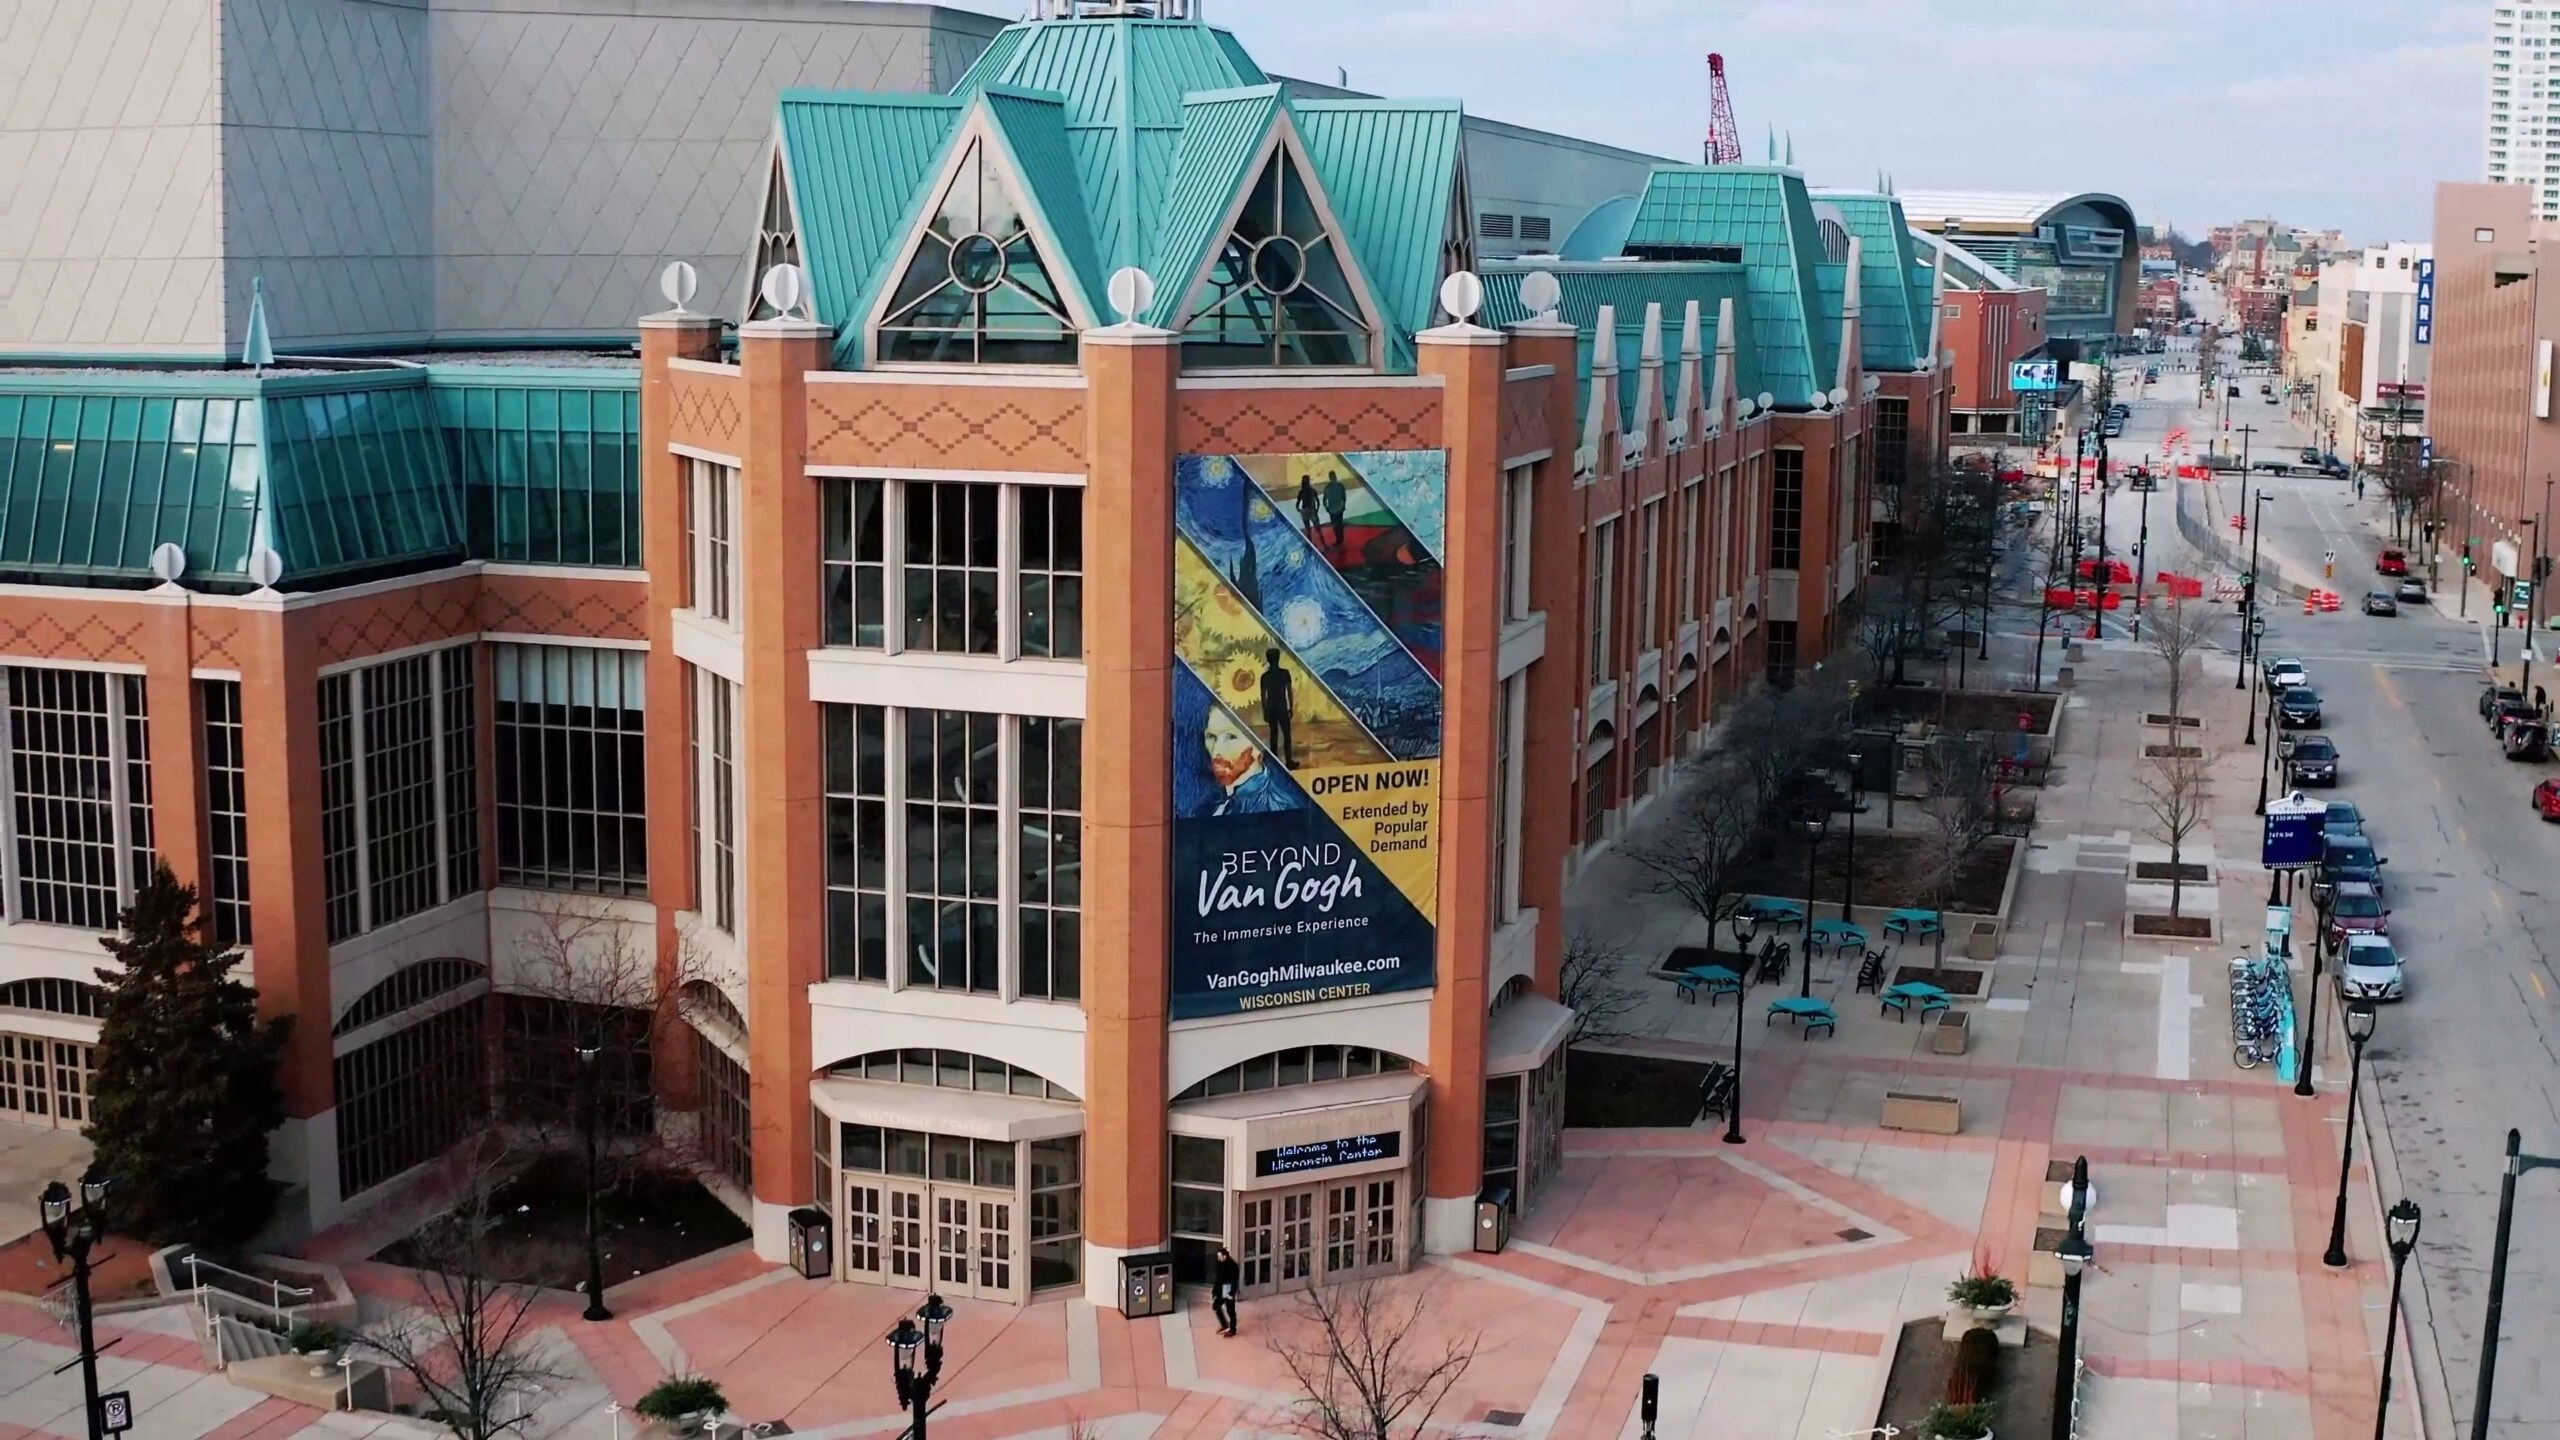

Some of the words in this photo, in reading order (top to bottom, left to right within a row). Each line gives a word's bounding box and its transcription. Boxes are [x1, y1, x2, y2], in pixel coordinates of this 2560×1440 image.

[2418, 262, 2431, 342] PARK
[1312, 773, 1369, 795] OPEN
[1376, 768, 1429, 790] NOW!
[1343, 801, 1408, 820] Extended
[1412, 800, 1428, 817] by
[1374, 818, 1428, 836] Popular
[1370, 835, 1427, 853] Demand
[1222, 843, 1341, 875] BEYOND
[1198, 869, 1265, 917] Van
[1274, 858, 1362, 912] Gogh
[1193, 932, 1218, 944] The
[1223, 923, 1292, 941] Immersive
[1297, 917, 1369, 934] Experience
[1206, 956, 1401, 990] VanGoghMilwaukee.com
[1239, 989, 1316, 1010] WISCONSIN
[1318, 982, 1371, 999] CENTER
[1356, 1134, 1377, 1146] the
